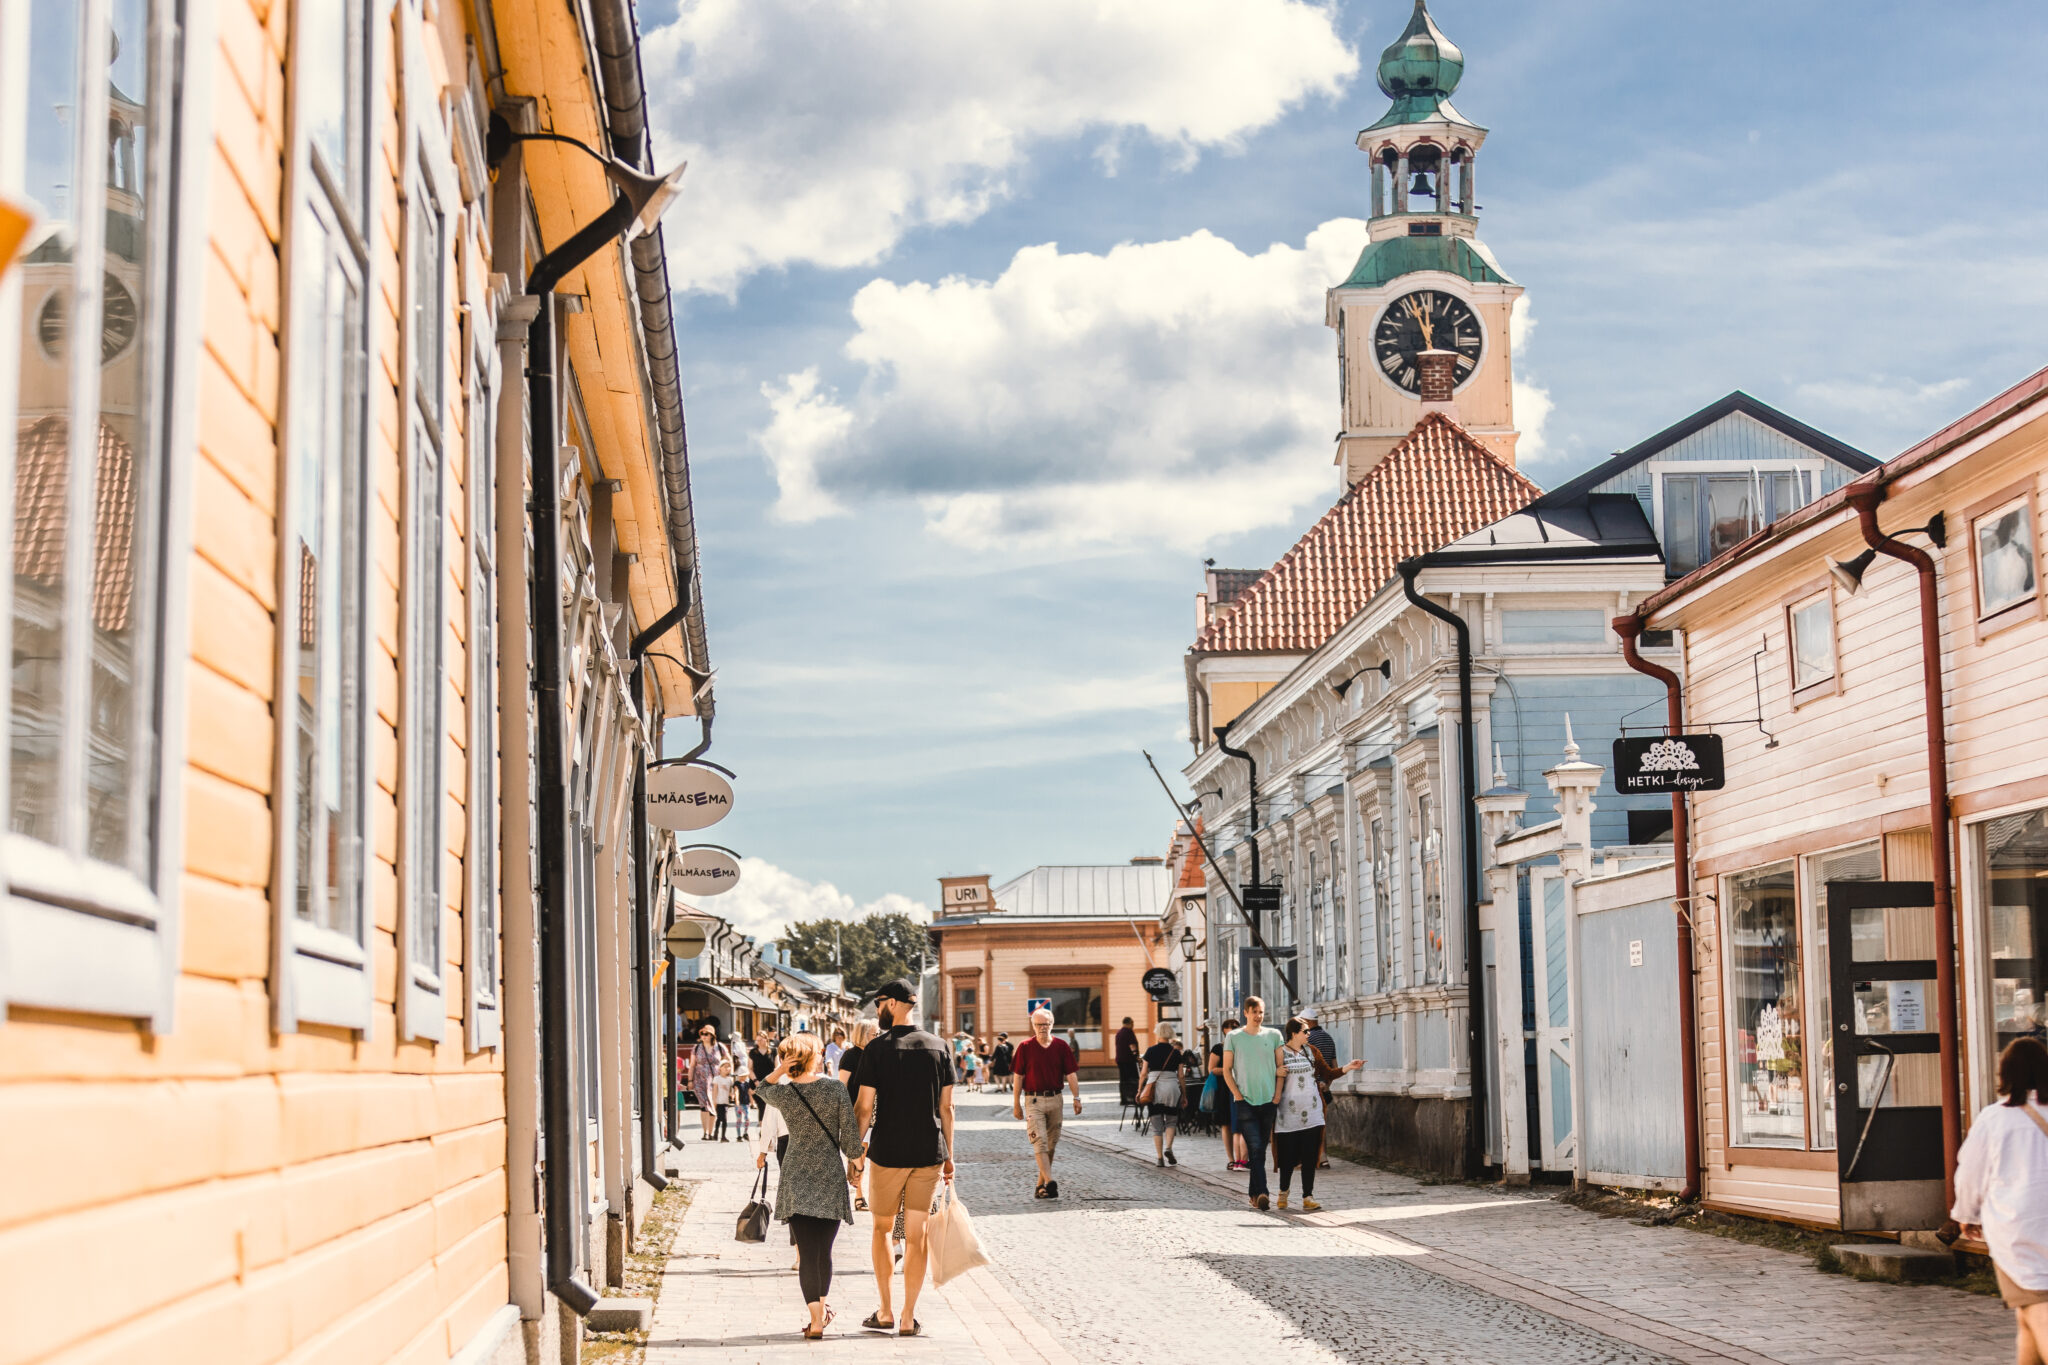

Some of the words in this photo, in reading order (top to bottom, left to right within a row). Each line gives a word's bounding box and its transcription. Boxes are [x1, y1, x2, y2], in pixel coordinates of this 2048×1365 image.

[1627, 775, 1665, 787] HETKI
[1666, 771, 1714, 791] design
[647, 791, 728, 807] ILMÄASEMA
